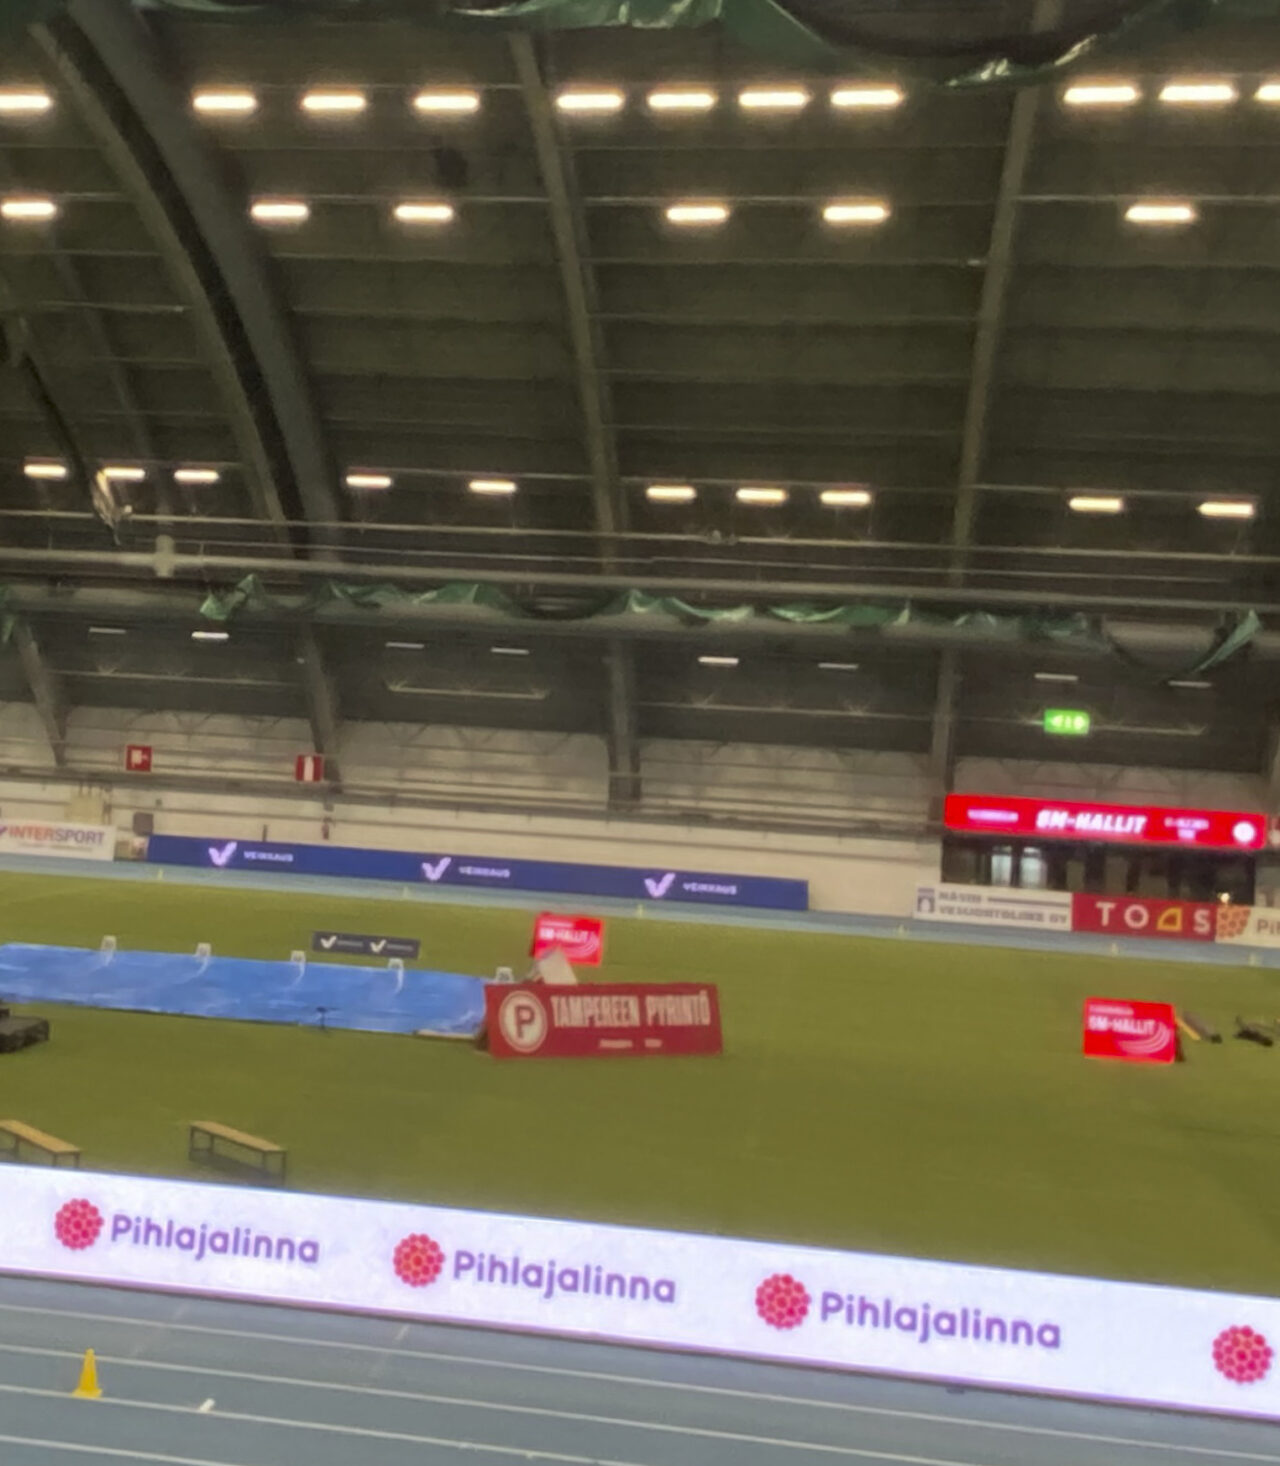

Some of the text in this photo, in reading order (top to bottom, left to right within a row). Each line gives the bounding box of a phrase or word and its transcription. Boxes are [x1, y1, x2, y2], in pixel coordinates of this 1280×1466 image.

[9, 825, 106, 845] INTERSPORT
[1036, 810, 1147, 835] SM-HALLIT
[551, 989, 711, 1028] TAMPEREEN PYRINTÖ
[111, 1213, 320, 1264] Pihlajalinna
[453, 1250, 677, 1304] Pihlajalinna
[820, 1291, 1062, 1351] Pihlajalinna
